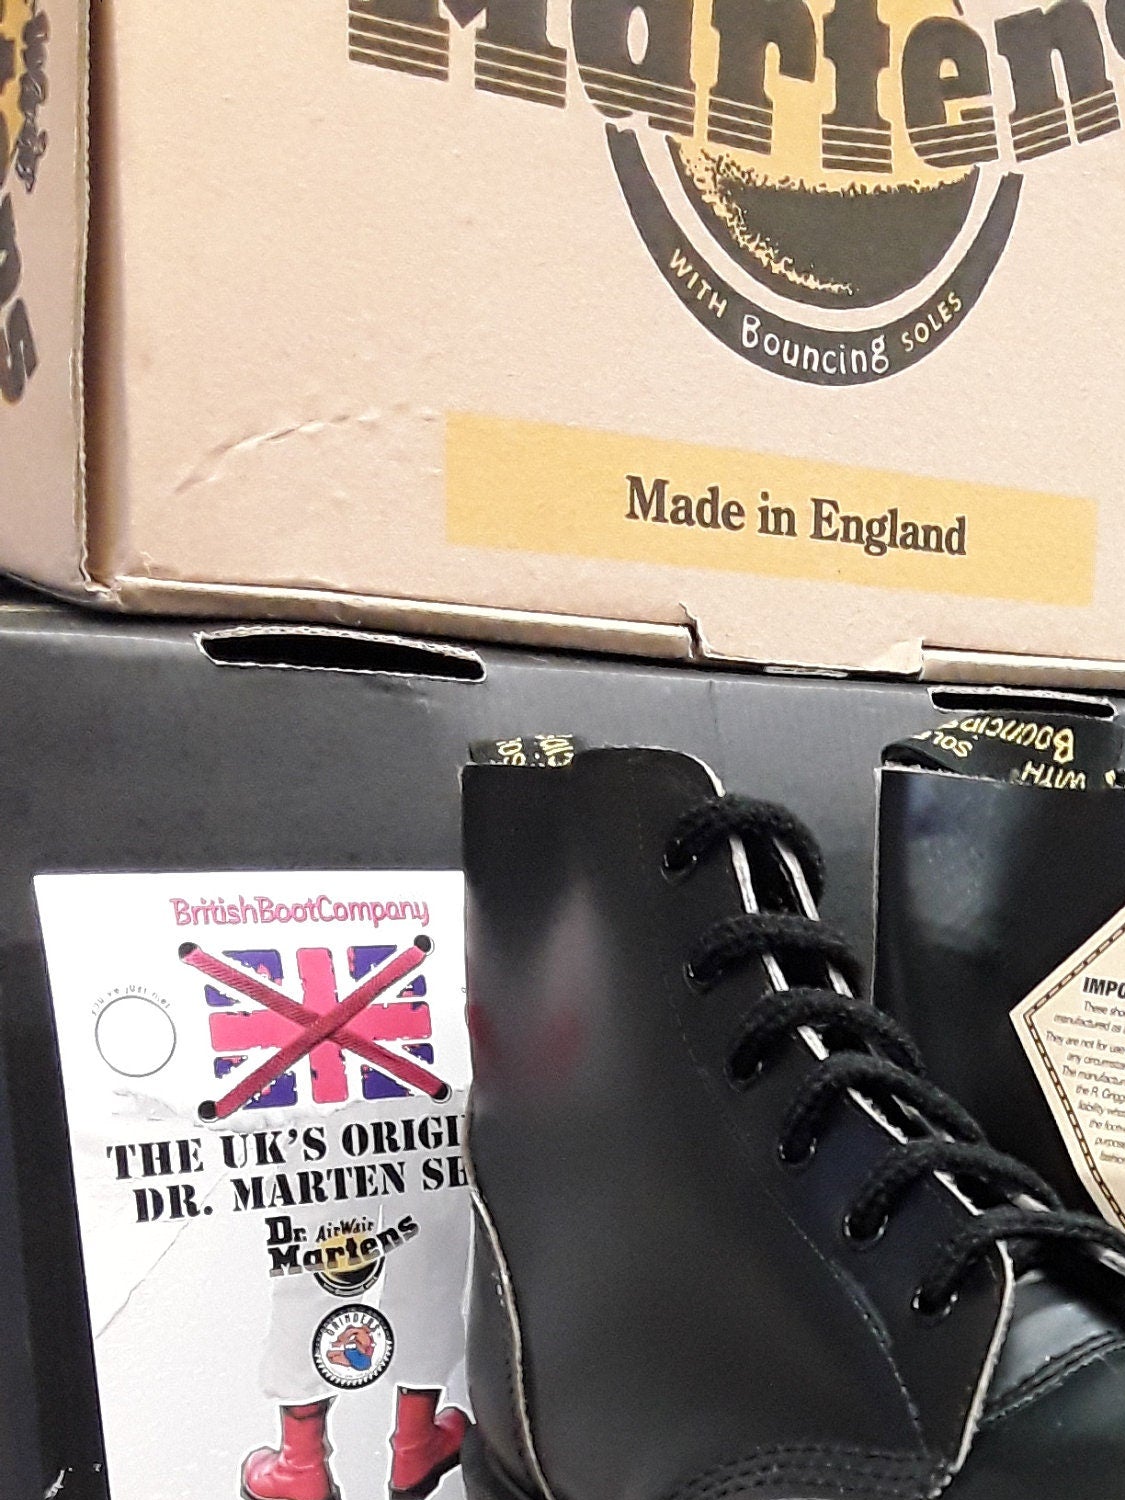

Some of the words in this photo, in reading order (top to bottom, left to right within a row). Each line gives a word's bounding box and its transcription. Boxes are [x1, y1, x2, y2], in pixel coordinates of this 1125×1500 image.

[668, 247, 729, 319] WITH
[740, 313, 891, 376] Bouncing
[900, 290, 963, 353] SOLES
[624, 474, 747, 537] Made
[756, 490, 799, 541] in
[808, 498, 969, 560] England
[1020, 760, 1087, 791] WITH
[169, 894, 431, 928] BritishBootCompany
[105, 1137, 205, 1180] THE
[220, 1125, 329, 1170] UK'S
[341, 1113, 467, 1158] ORIGI
[132, 1184, 215, 1224] DR.
[231, 1161, 408, 1214] MARTEN
[264, 1214, 308, 1246] Dr.
[267, 1214, 421, 1279] Martens
[315, 1216, 375, 1243] AirWair
[323, 1311, 381, 1338] GRINDERS
